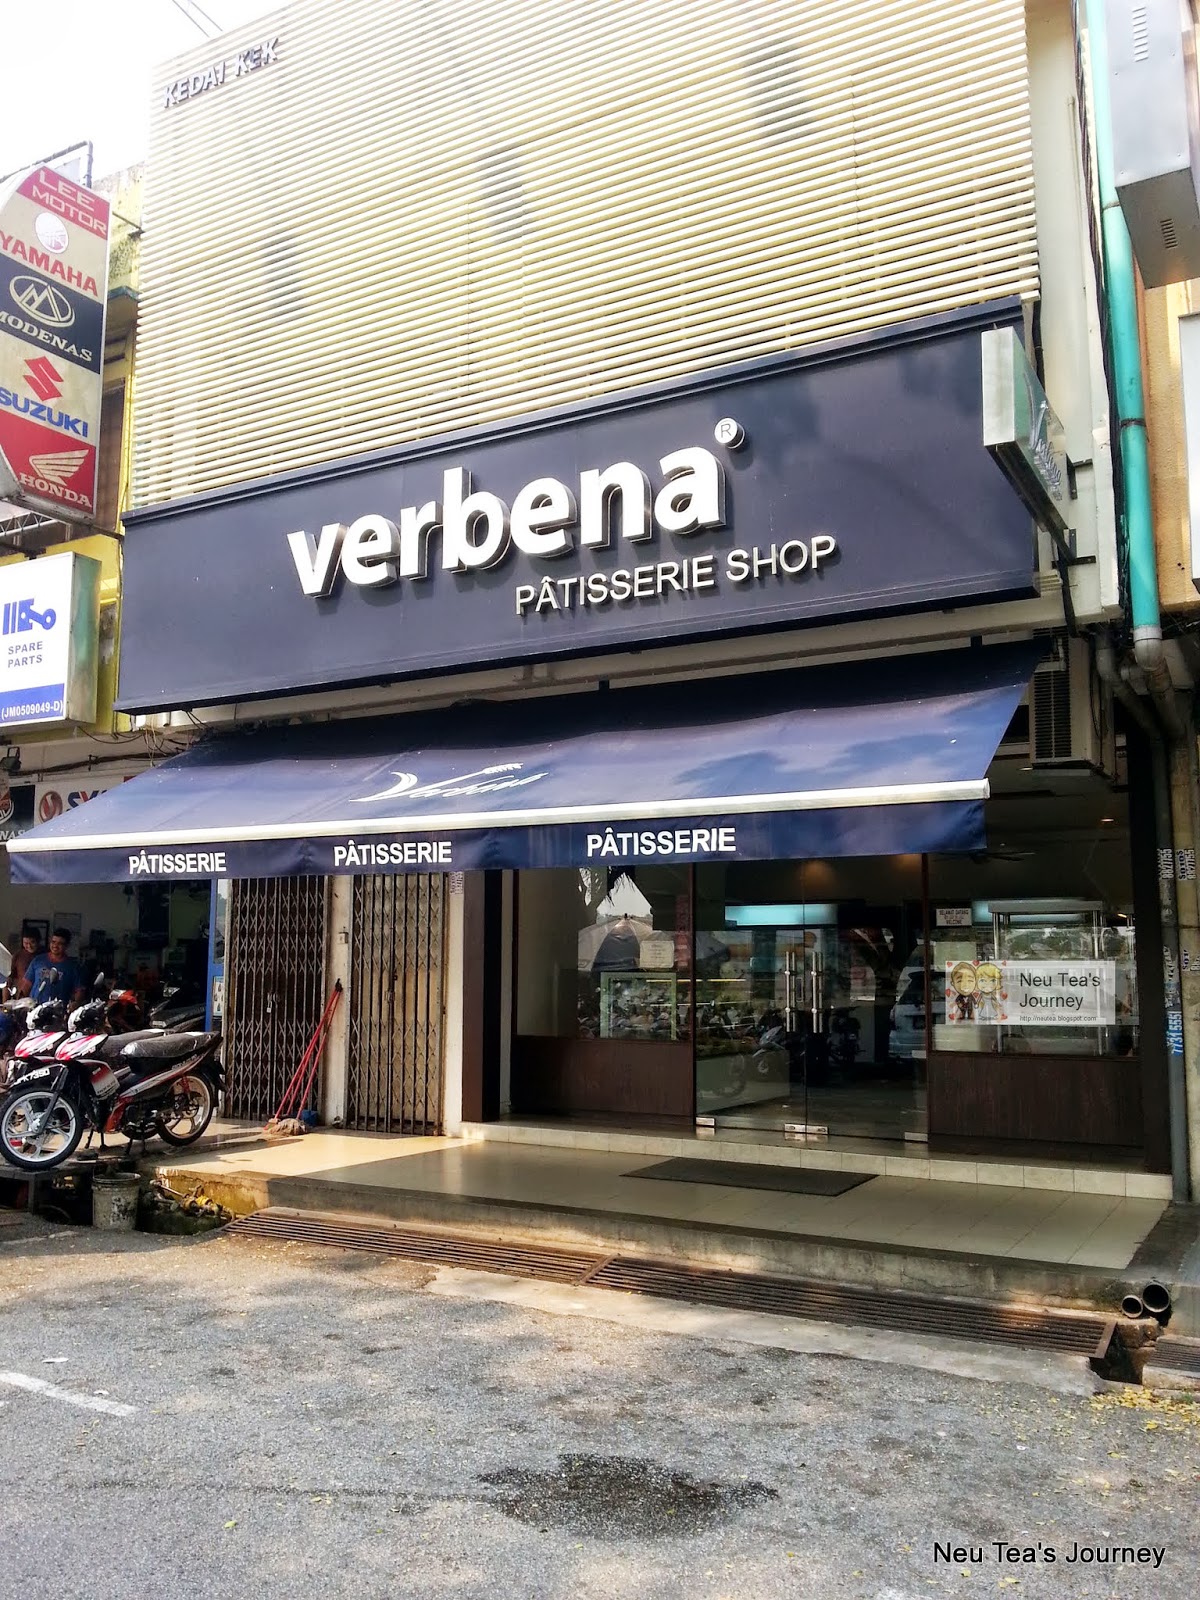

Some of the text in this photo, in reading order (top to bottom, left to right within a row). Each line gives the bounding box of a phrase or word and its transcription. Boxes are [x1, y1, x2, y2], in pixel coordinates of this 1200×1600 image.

[164, 37, 279, 108] KEDAI KEK
[39, 169, 95, 212] LEE
[32, 187, 107, 236] MOTOR
[0, 230, 98, 297] YAMAHA
[0, 386, 88, 438] SUZUKI
[20, 472, 93, 508] HONDA
[287, 446, 726, 598] verbena
[515, 534, 837, 616] PÂTISSERIE SHOP
[8, 640, 43, 656] SPARE
[8, 654, 43, 669] PARTS
[1, 700, 64, 721] (JM0509049-D)
[333, 839, 453, 866] PÂTISSERIE
[587, 827, 737, 857] PÂTISSERIE
[128, 850, 227, 875] PÂTISSERIE
